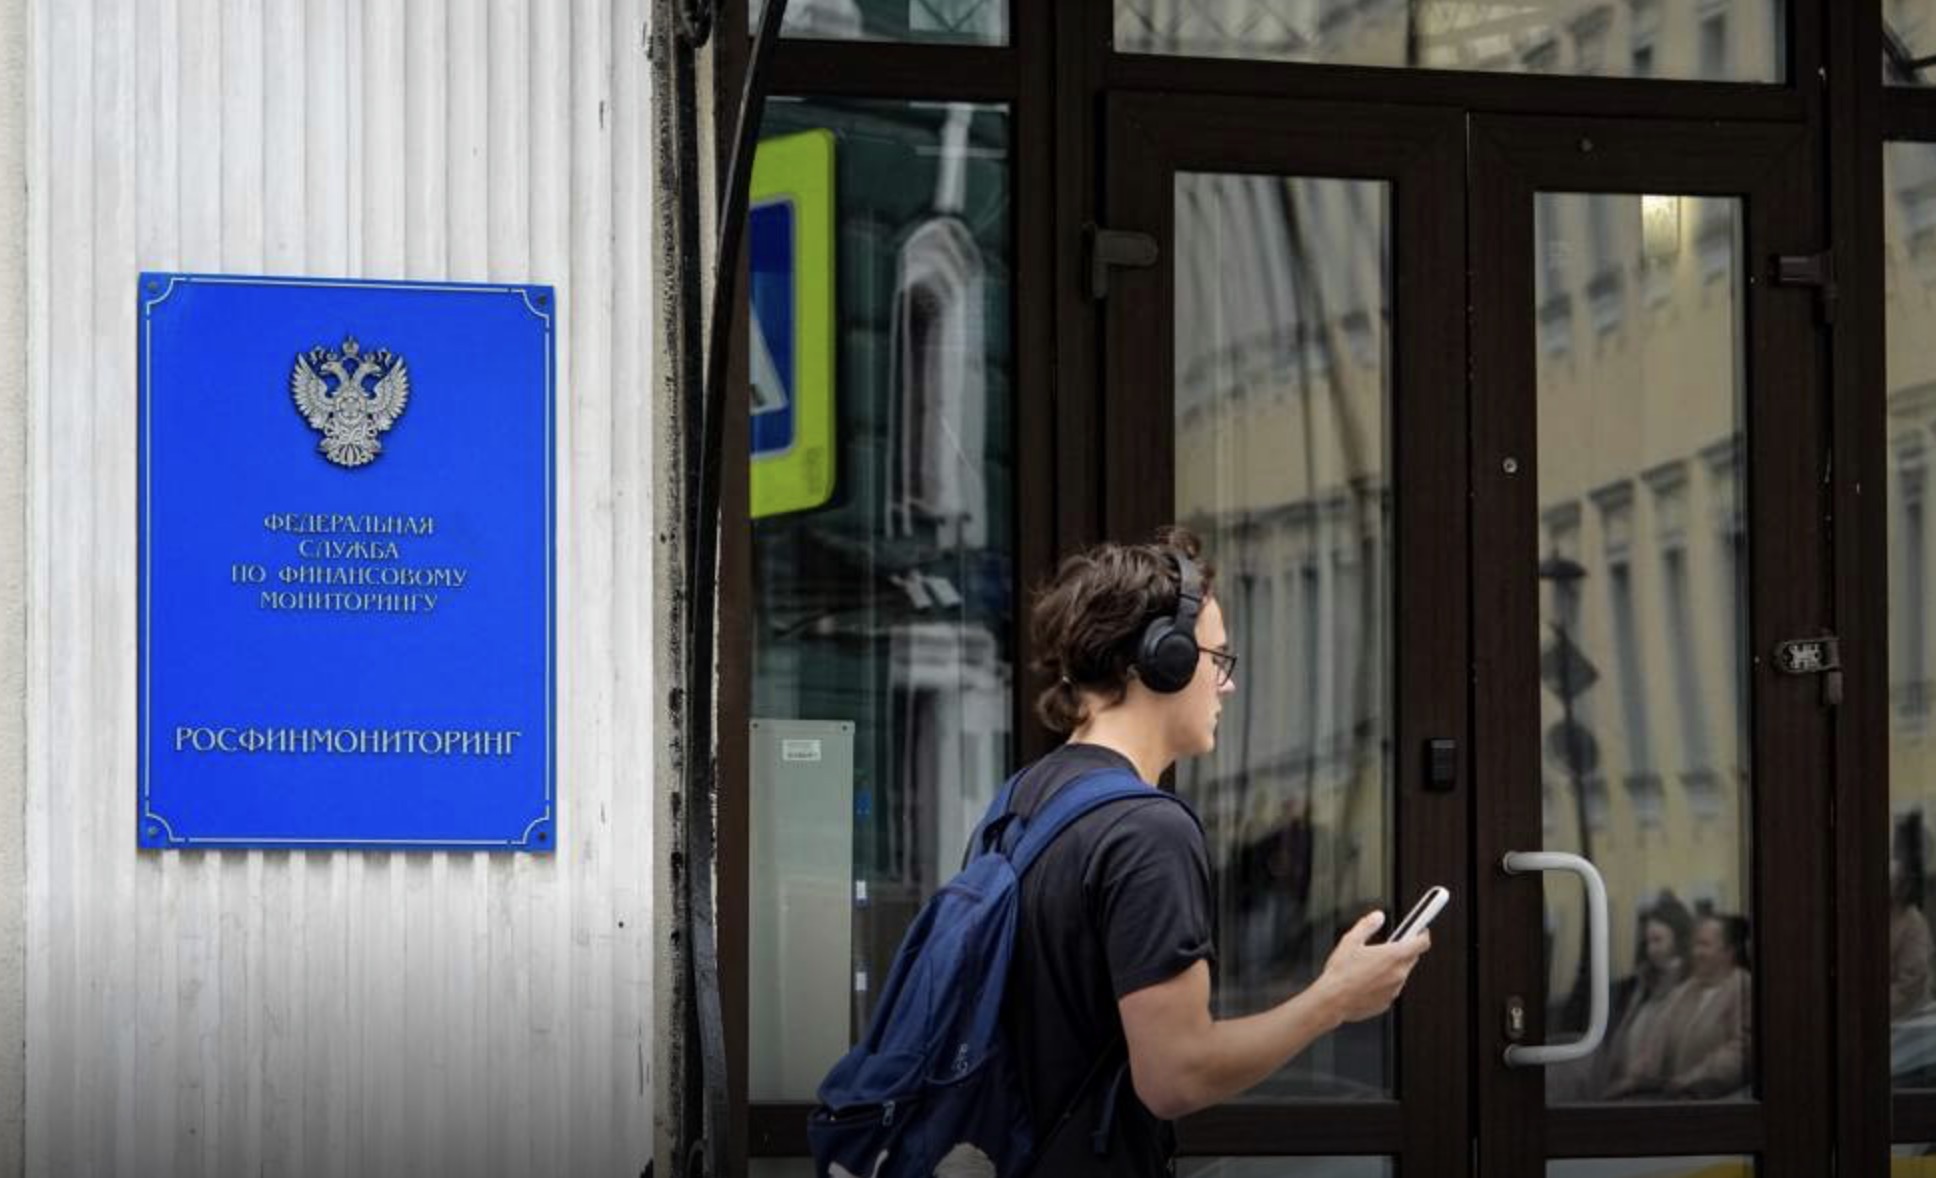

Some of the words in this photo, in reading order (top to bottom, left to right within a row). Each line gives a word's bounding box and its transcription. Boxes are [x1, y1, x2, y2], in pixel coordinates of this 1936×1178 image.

[264, 513, 434, 535] ФЕДЕРАЛЬНАЯ
[298, 540, 399, 559] СЛУЖБА
[232, 565, 266, 583] ПО
[278, 565, 466, 587] ФИНАНСОВОМУ
[261, 591, 438, 612] МОНИТОРИНГУ
[176, 727, 522, 755] РОСФИНМОНИТОРИНГ
